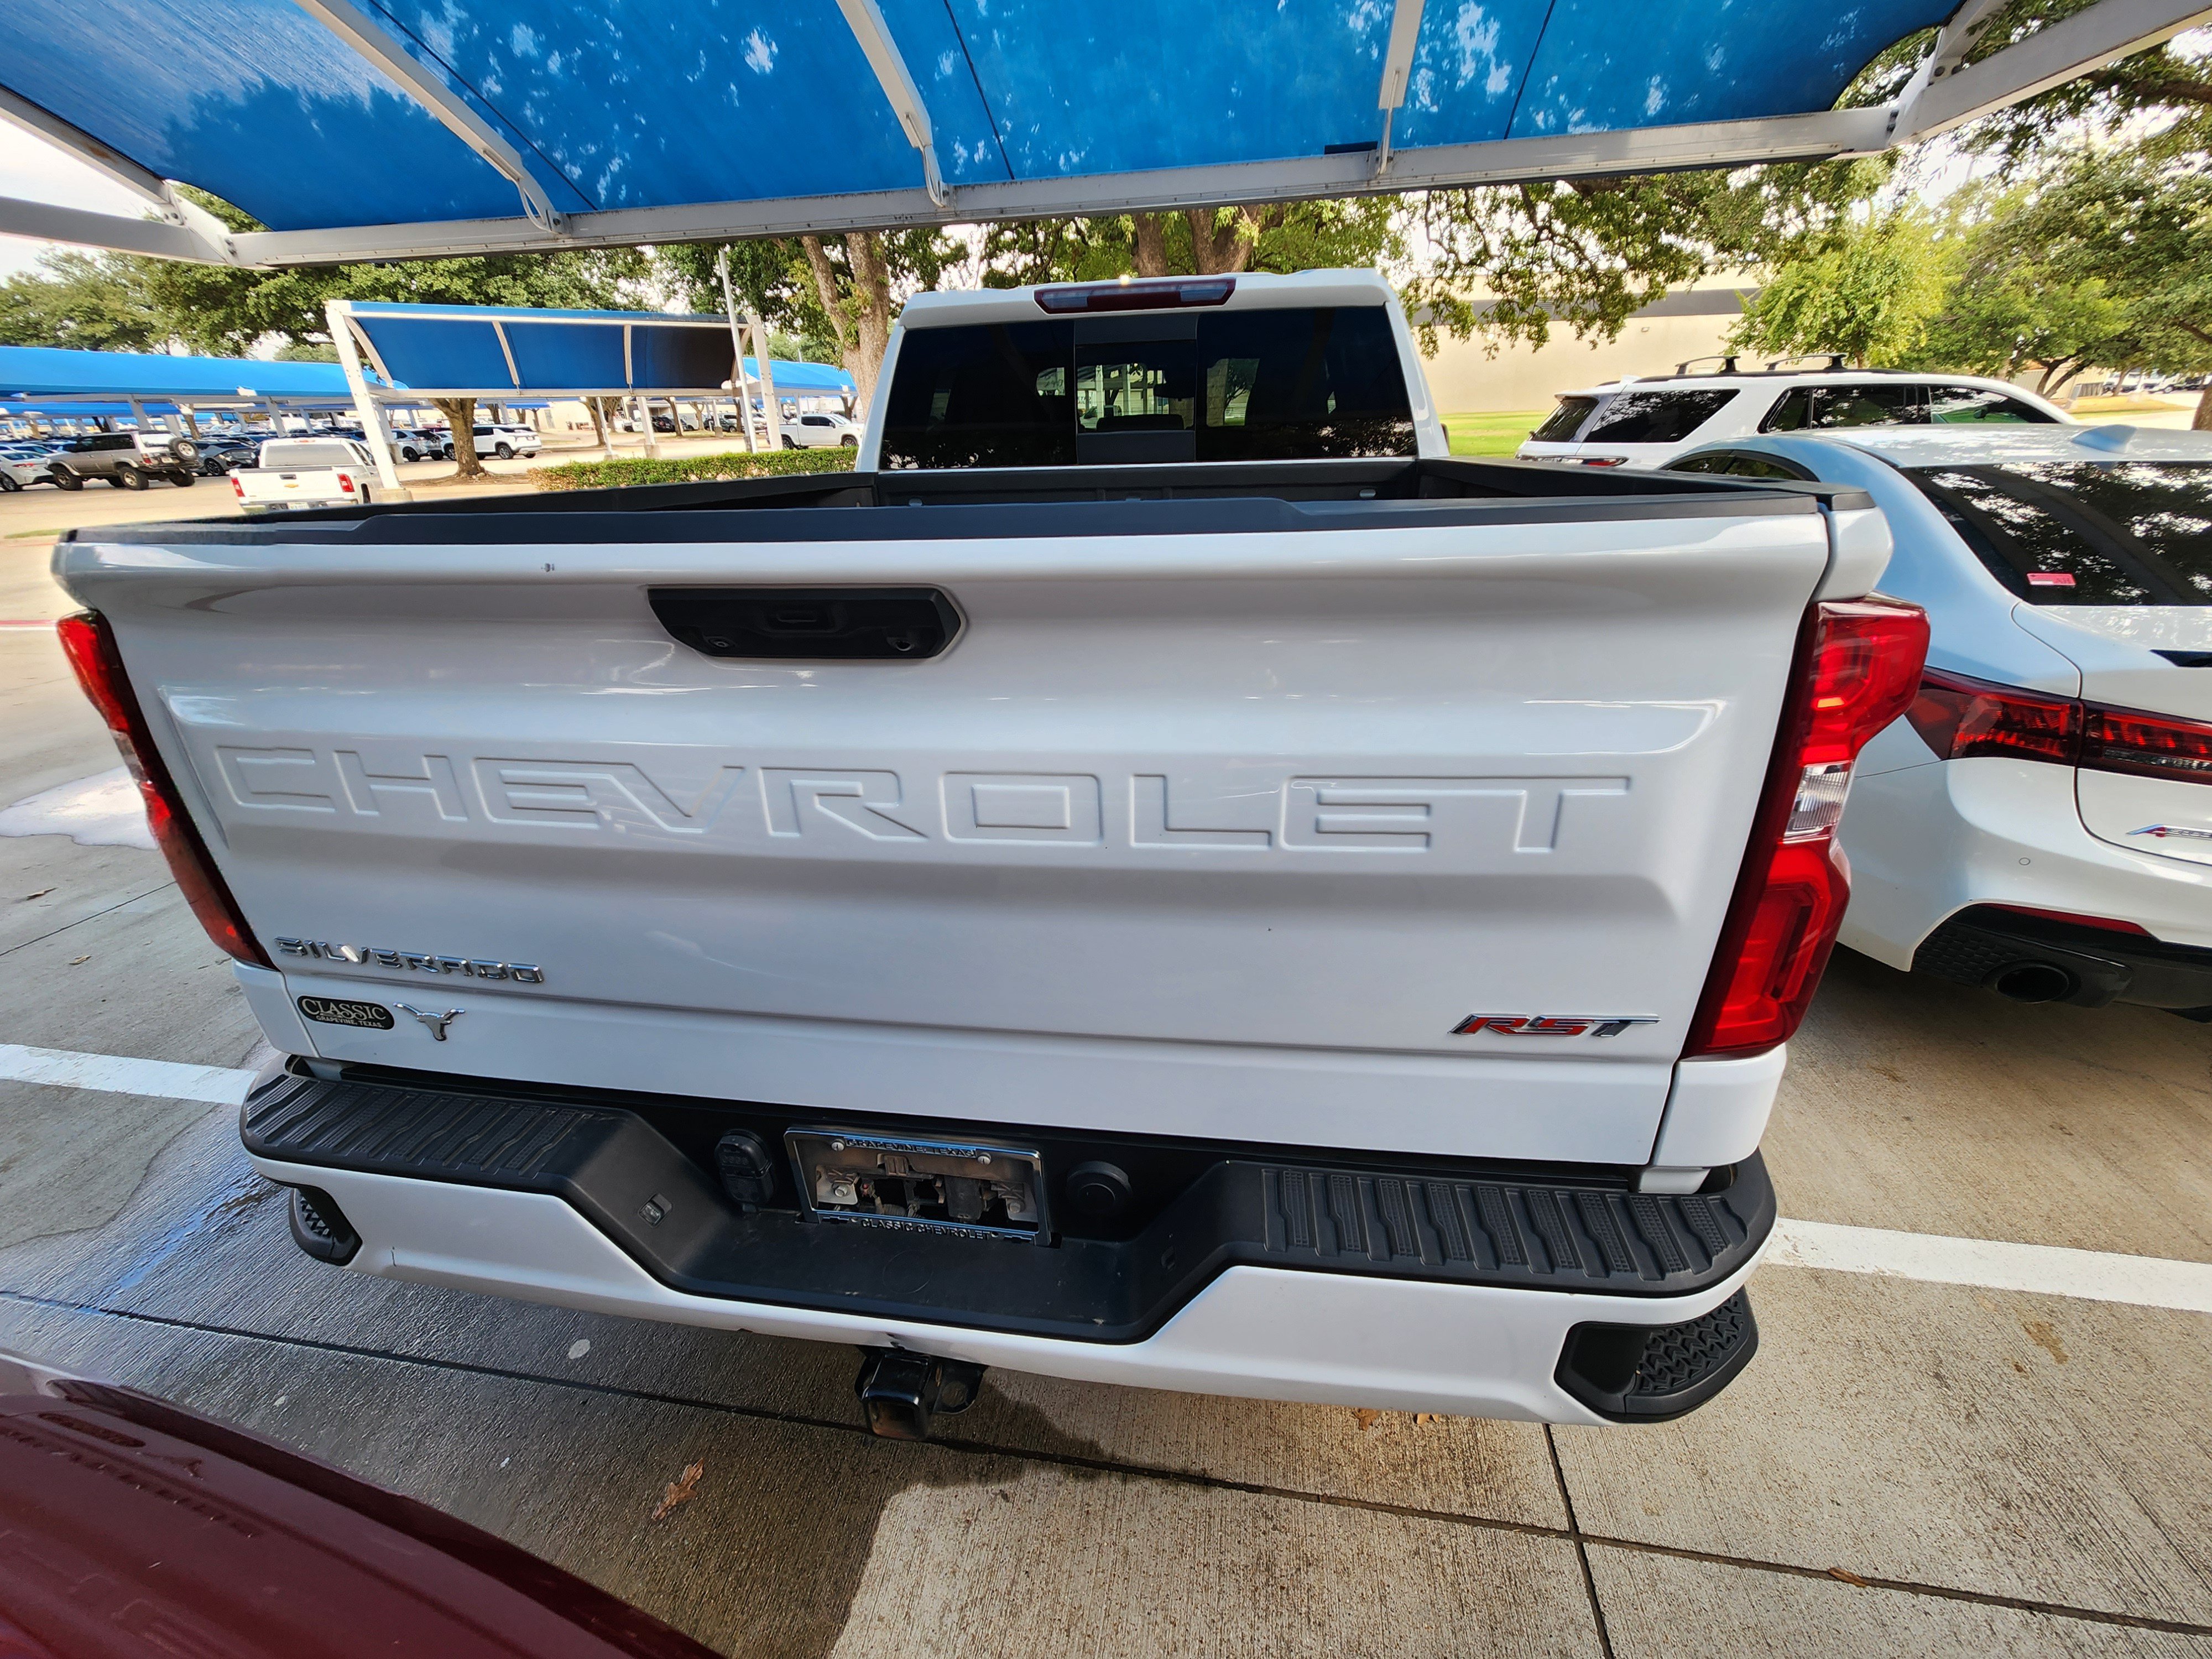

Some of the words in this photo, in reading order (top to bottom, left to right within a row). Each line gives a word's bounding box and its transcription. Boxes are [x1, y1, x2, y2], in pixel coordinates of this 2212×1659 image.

[217, 745, 1631, 854] CHEVROLET
[274, 936, 545, 983] SILVERADO
[301, 999, 387, 1020] CLASSIC
[1447, 1013, 1661, 1037] RST
[930, 1146, 977, 1157] TEXAS
[861, 1218, 914, 1232] CLASSIC
[916, 1224, 991, 1240] CHEVROLET
